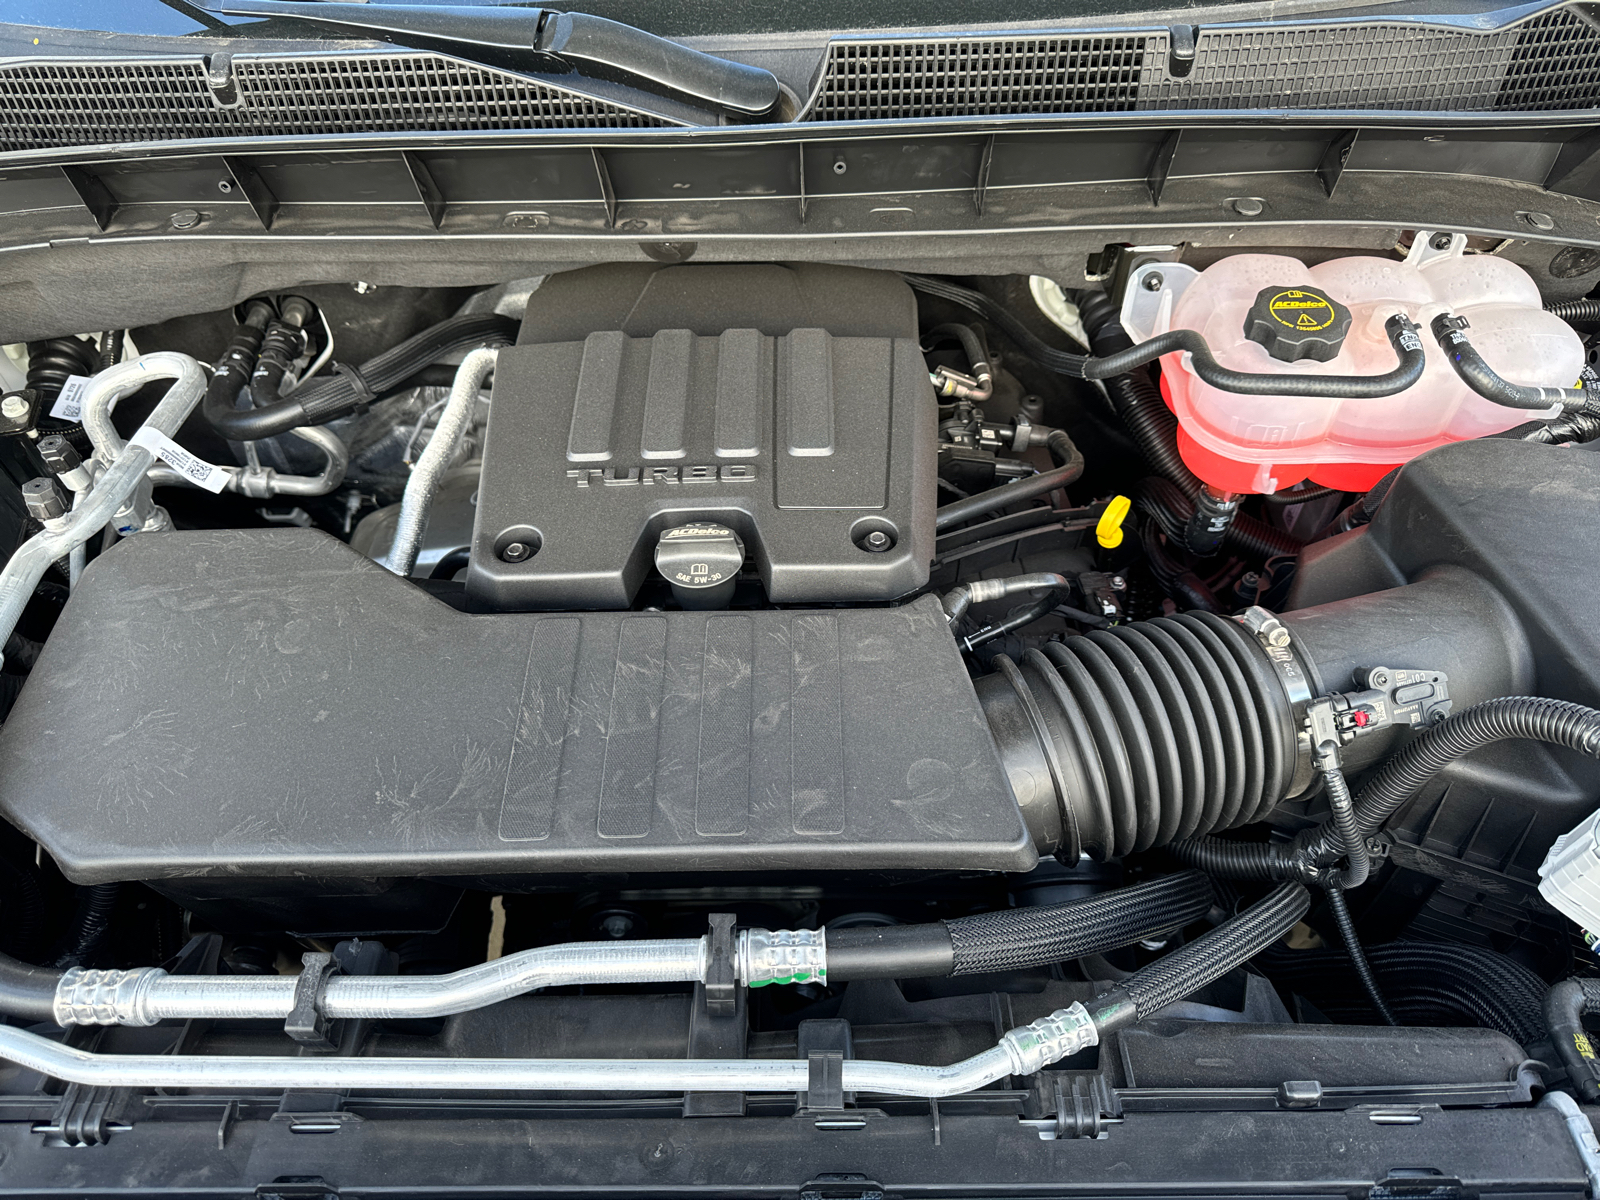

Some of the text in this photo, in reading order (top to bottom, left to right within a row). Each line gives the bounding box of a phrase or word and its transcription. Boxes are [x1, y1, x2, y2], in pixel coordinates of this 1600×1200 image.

[1273, 300, 1327, 309] ACDelco
[160, 452, 177, 466] 3285
[566, 464, 757, 488] TURBO
[667, 528, 730, 537] ACDelco
[675, 572, 722, 584] SAE 5W-30
